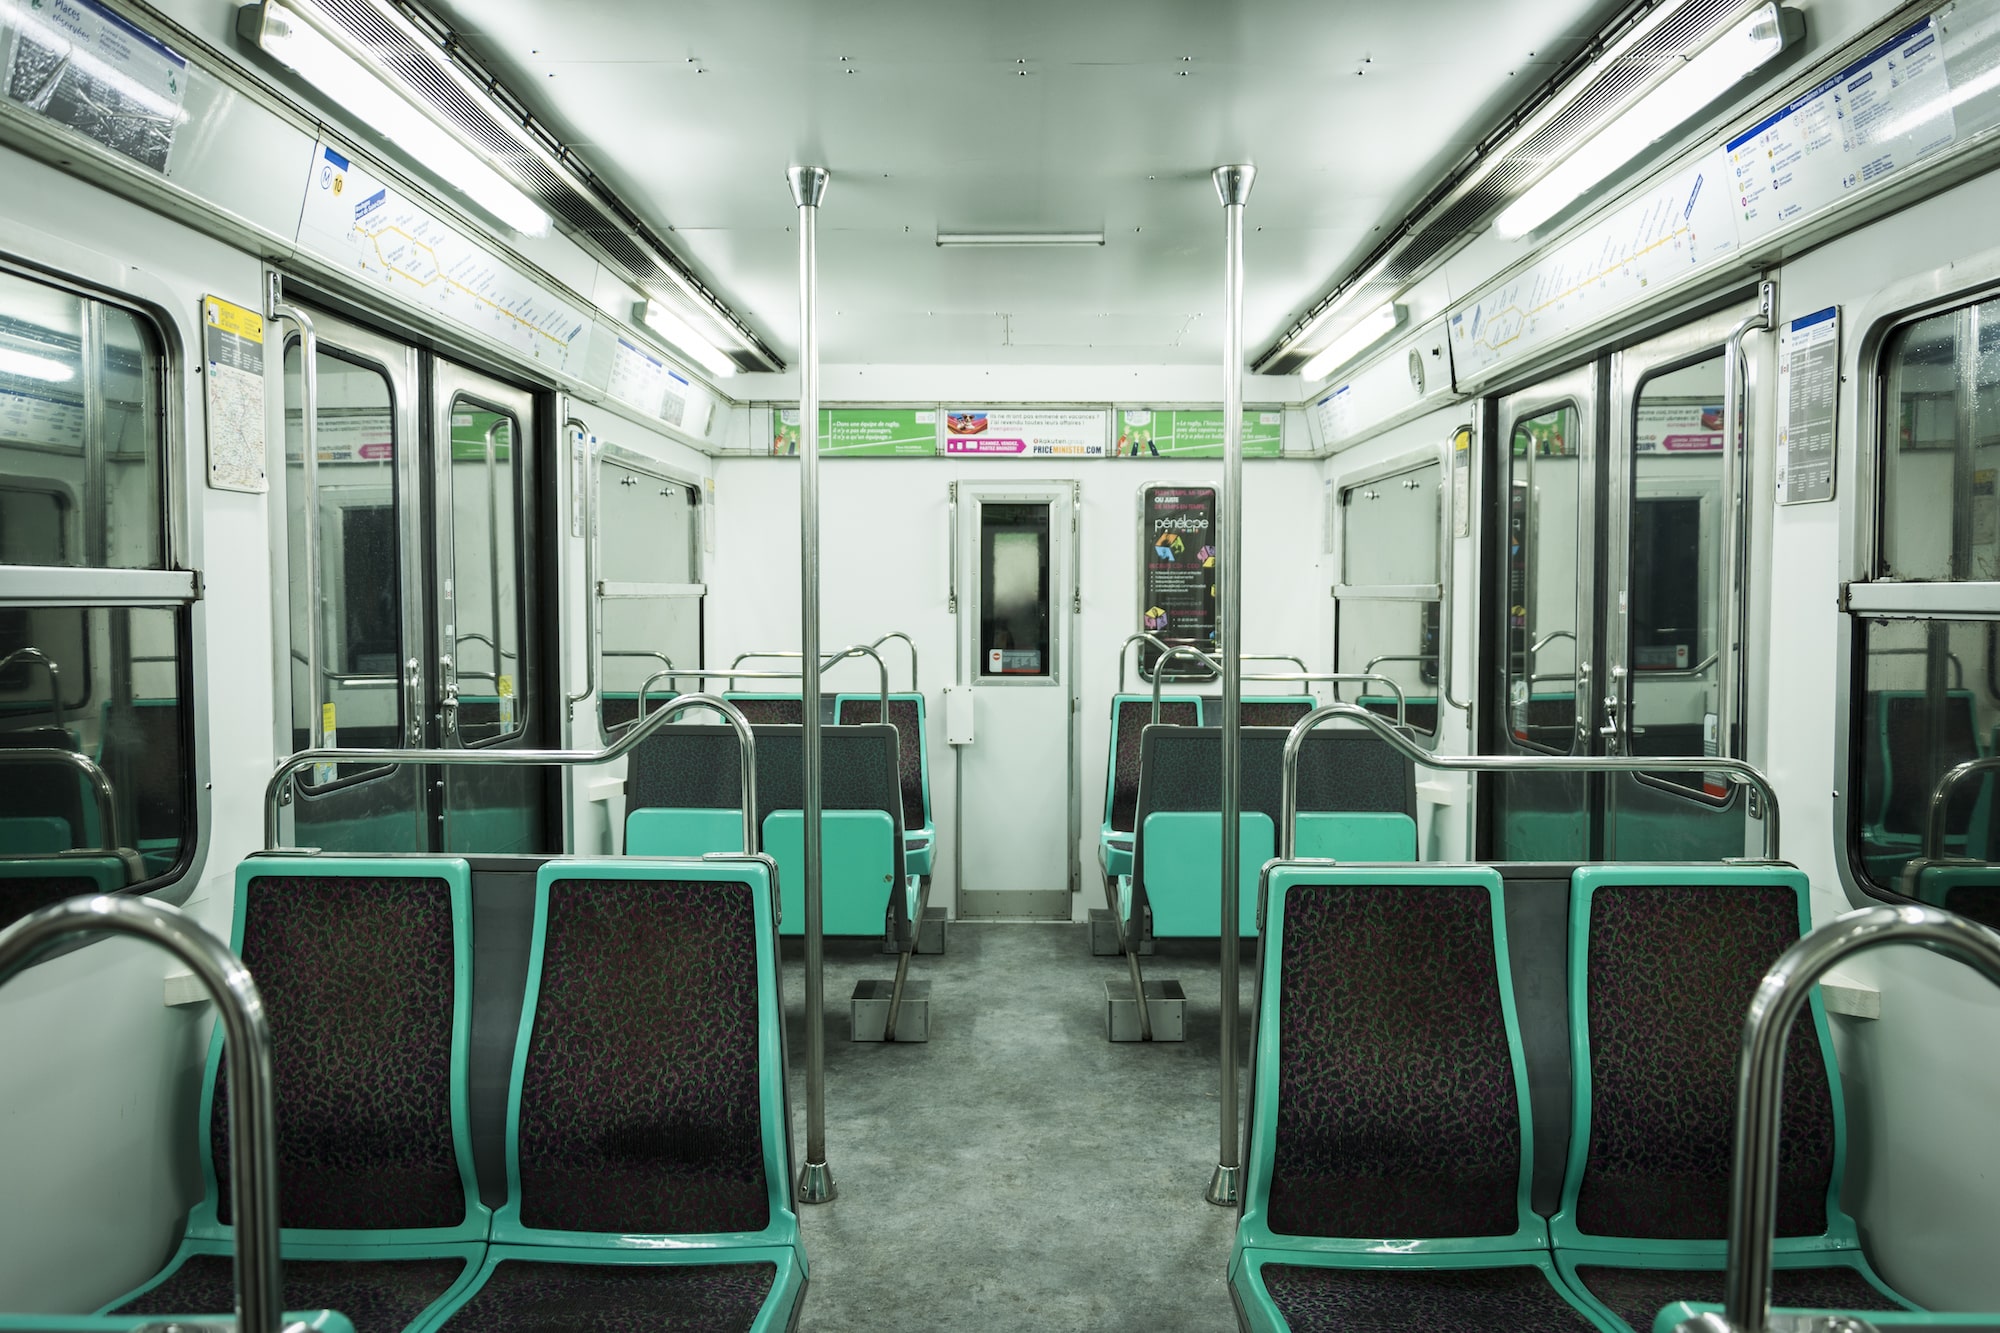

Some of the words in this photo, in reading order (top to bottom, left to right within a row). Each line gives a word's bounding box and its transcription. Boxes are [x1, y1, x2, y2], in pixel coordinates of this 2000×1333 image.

[55, 0, 80, 21] Places
[335, 178, 343, 193] 10
[1033, 445, 1102, 454] PRICEMINISTER.COM
[1155, 514, 1209, 532] pénélope
